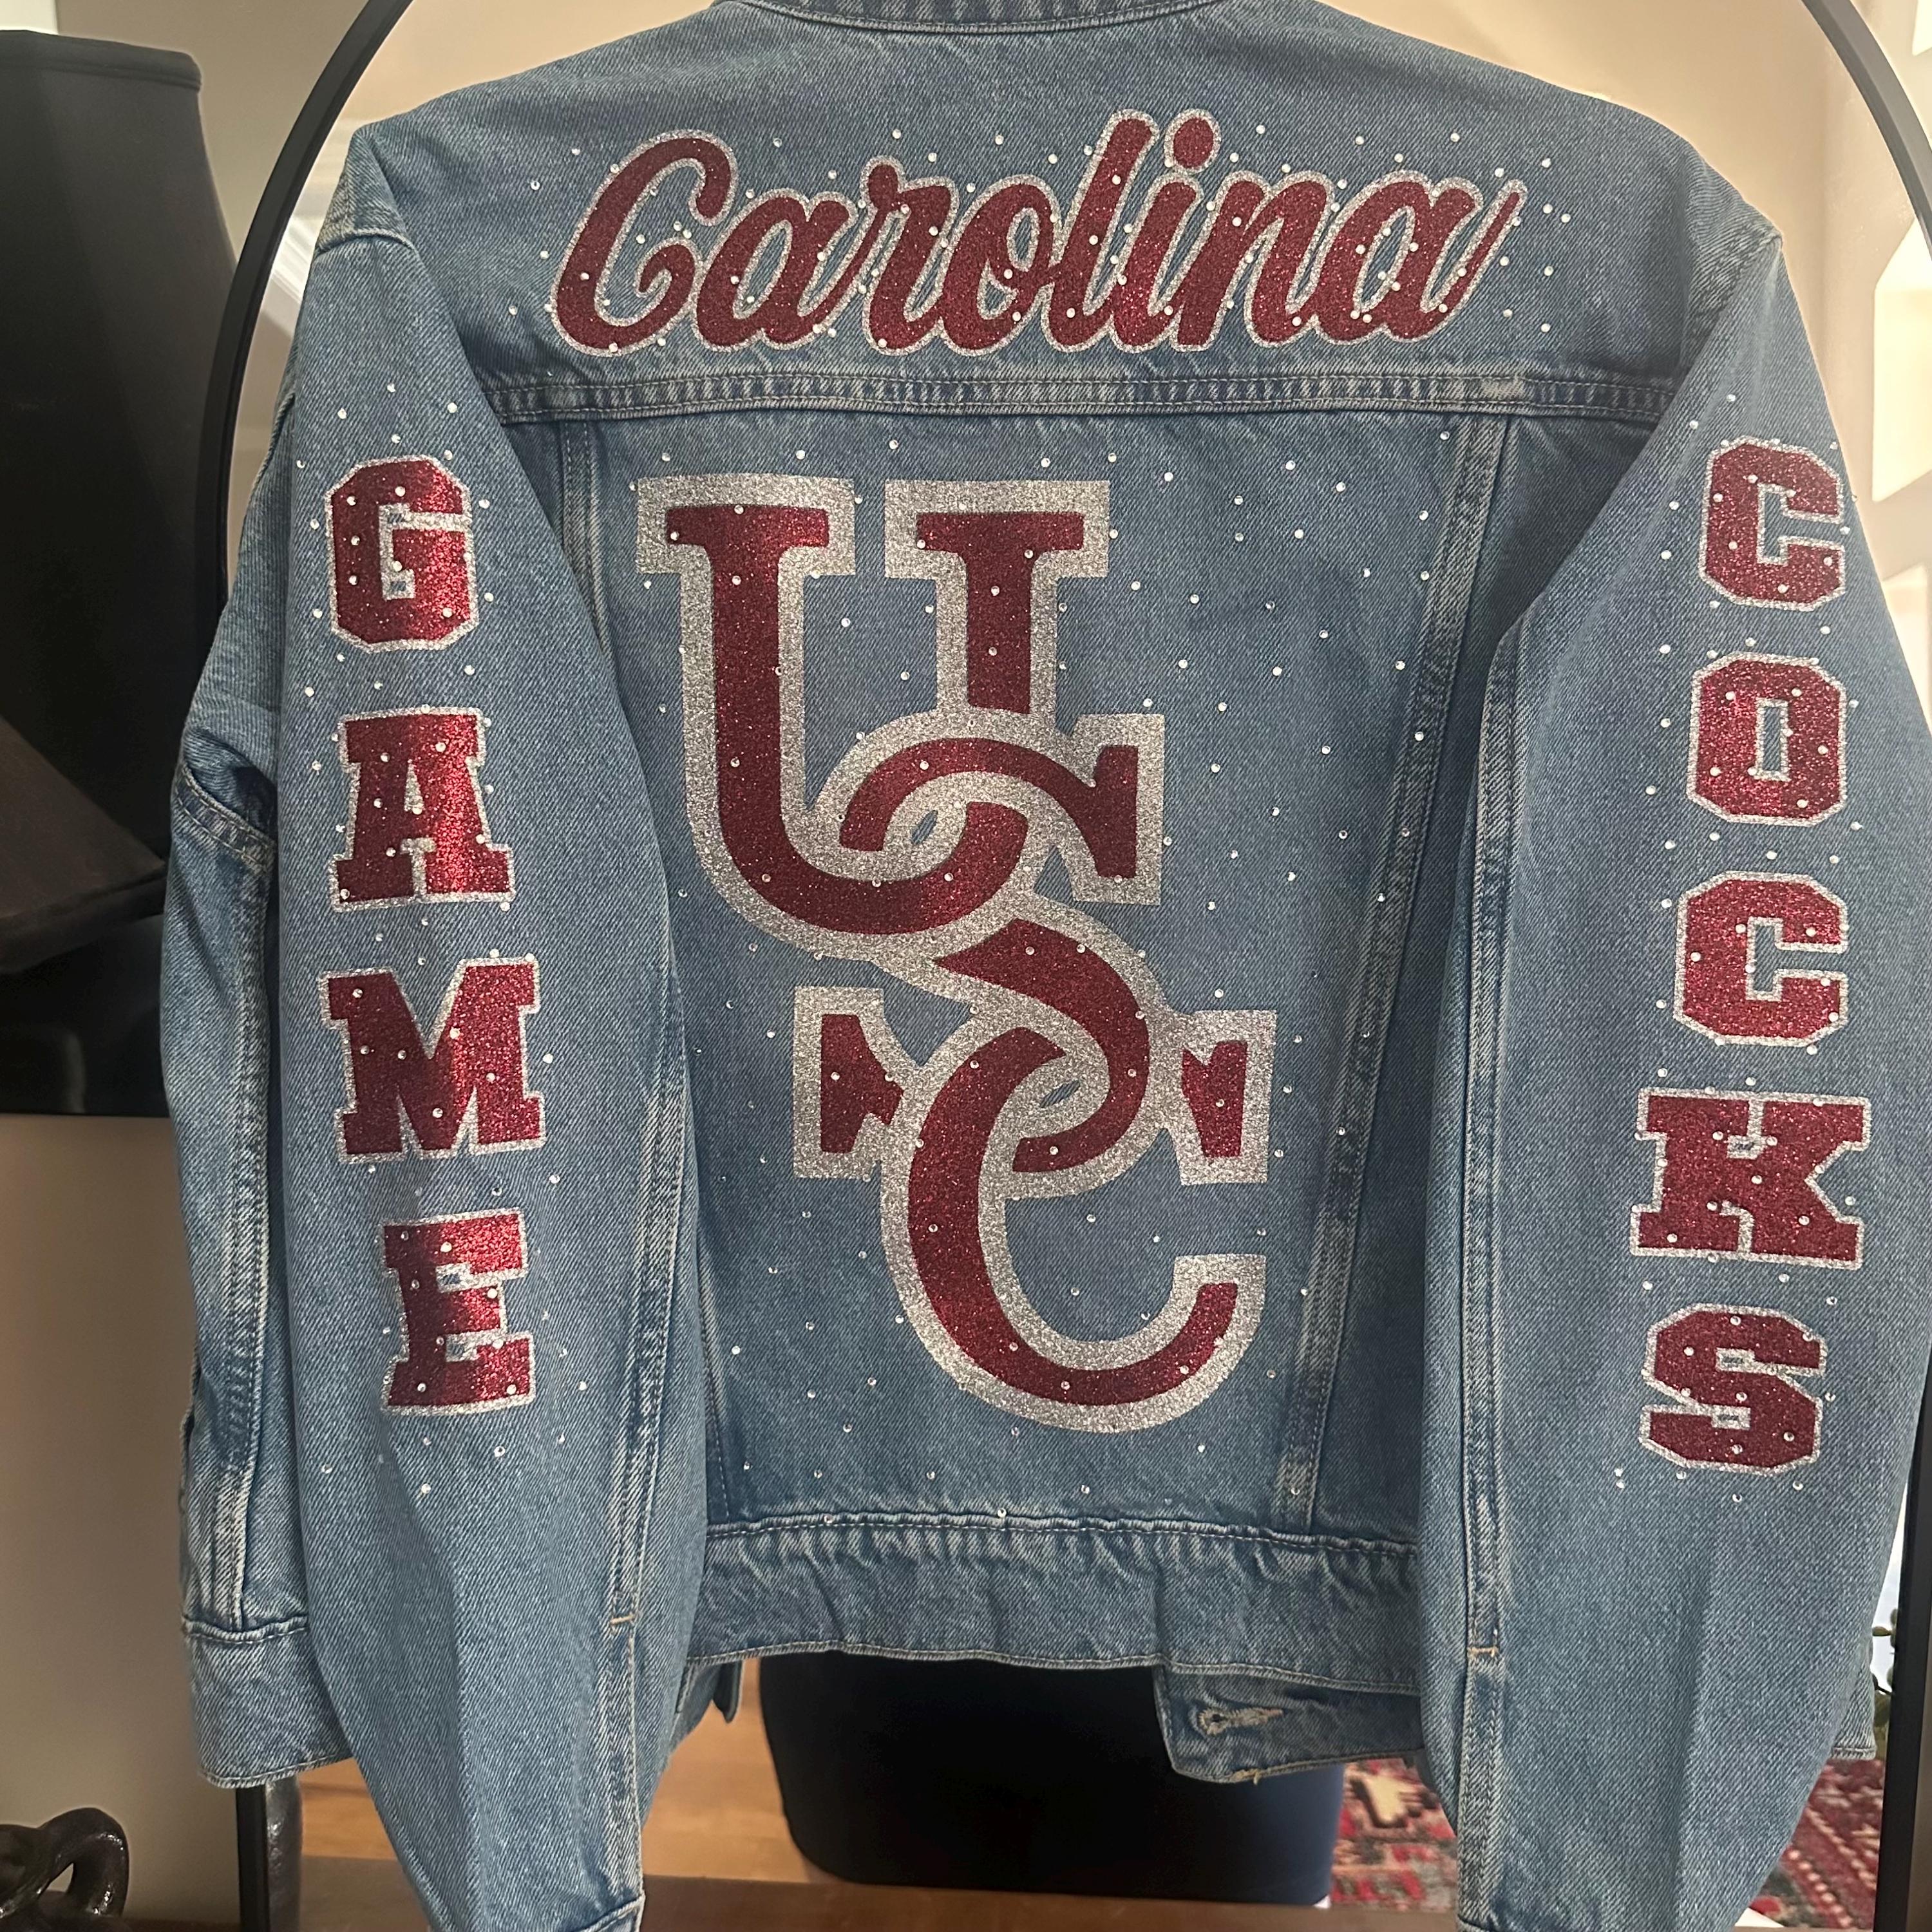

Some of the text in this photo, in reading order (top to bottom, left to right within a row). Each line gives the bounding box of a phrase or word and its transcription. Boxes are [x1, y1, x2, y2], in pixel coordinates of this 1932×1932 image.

[550, 108, 1528, 358] Carolina
[319, 455, 545, 1416] GAME
[636, 473, 1276, 1434] USC
[1630, 436, 1871, 1475] COCKS
